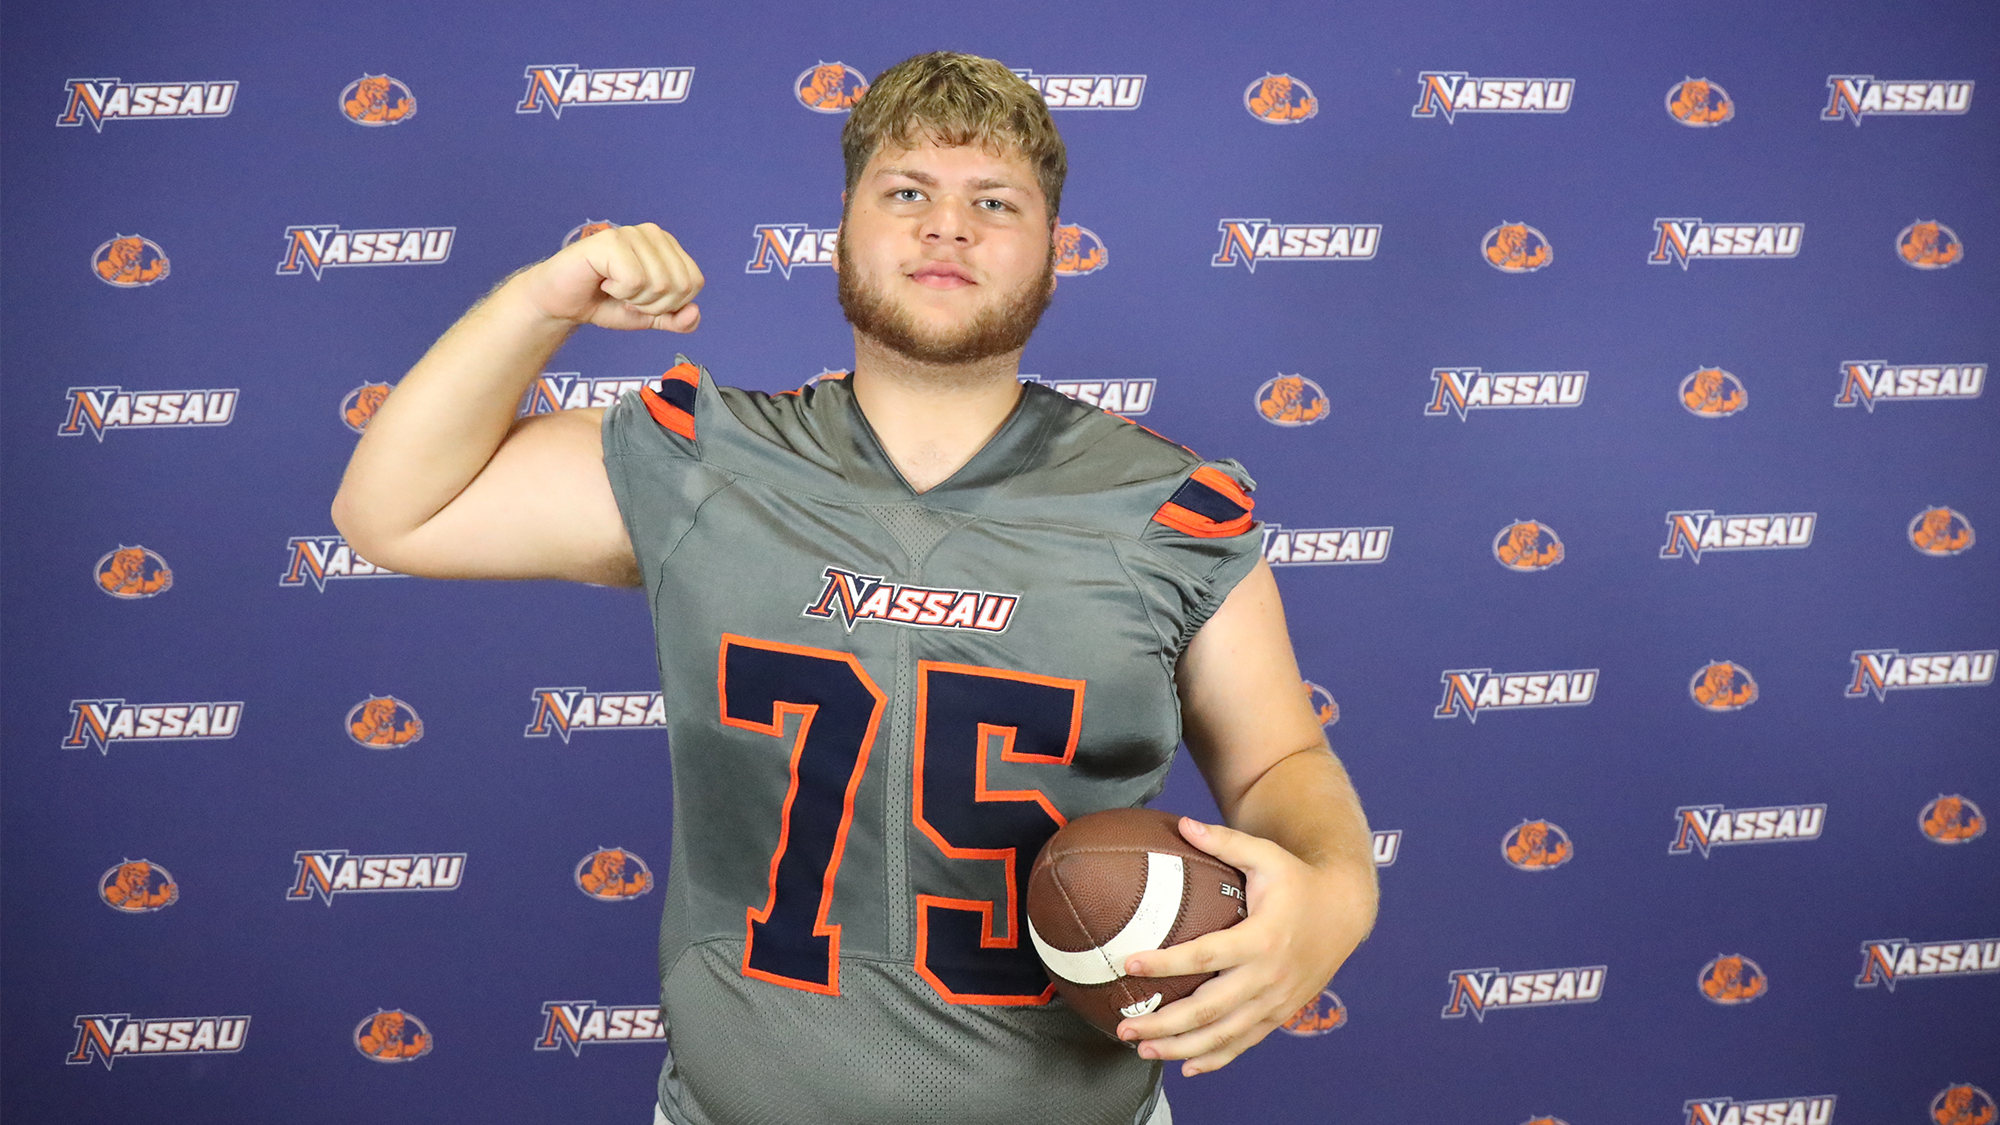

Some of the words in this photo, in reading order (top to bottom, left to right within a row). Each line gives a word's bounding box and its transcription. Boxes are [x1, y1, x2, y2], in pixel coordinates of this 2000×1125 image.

[56, 77, 239, 133] NASSAU
[516, 65, 695, 119] NASSAU
[1012, 69, 1147, 110] SSAU
[1411, 71, 1576, 125] NASSAU
[1820, 74, 1975, 126] NASSAU
[276, 225, 456, 280] NASSAU
[745, 223, 839, 280] NAS
[1211, 218, 1382, 274] NASSAU
[1648, 218, 1805, 271] NASSAU
[57, 386, 240, 443] NASSAU
[1424, 367, 1590, 422] NASSAU
[1834, 360, 1988, 413] NASSAU
[279, 536, 400, 593] NAS
[1659, 510, 1817, 564] NASSAU
[803, 566, 1020, 632] NASSAU
[1434, 669, 1599, 724] NASSAU
[1844, 649, 2000, 703] NASSAU
[61, 698, 245, 756] NASSAU
[525, 687, 667, 744] NASSA
[718, 633, 1086, 1005] 75
[1667, 804, 1828, 860] NASSAU
[286, 849, 468, 907] NASSAU
[1854, 938, 2000, 993] NASSAU
[1441, 965, 1608, 1023] NASSAU
[66, 1013, 251, 1071] NASSAU
[534, 1000, 667, 1057] NASS
